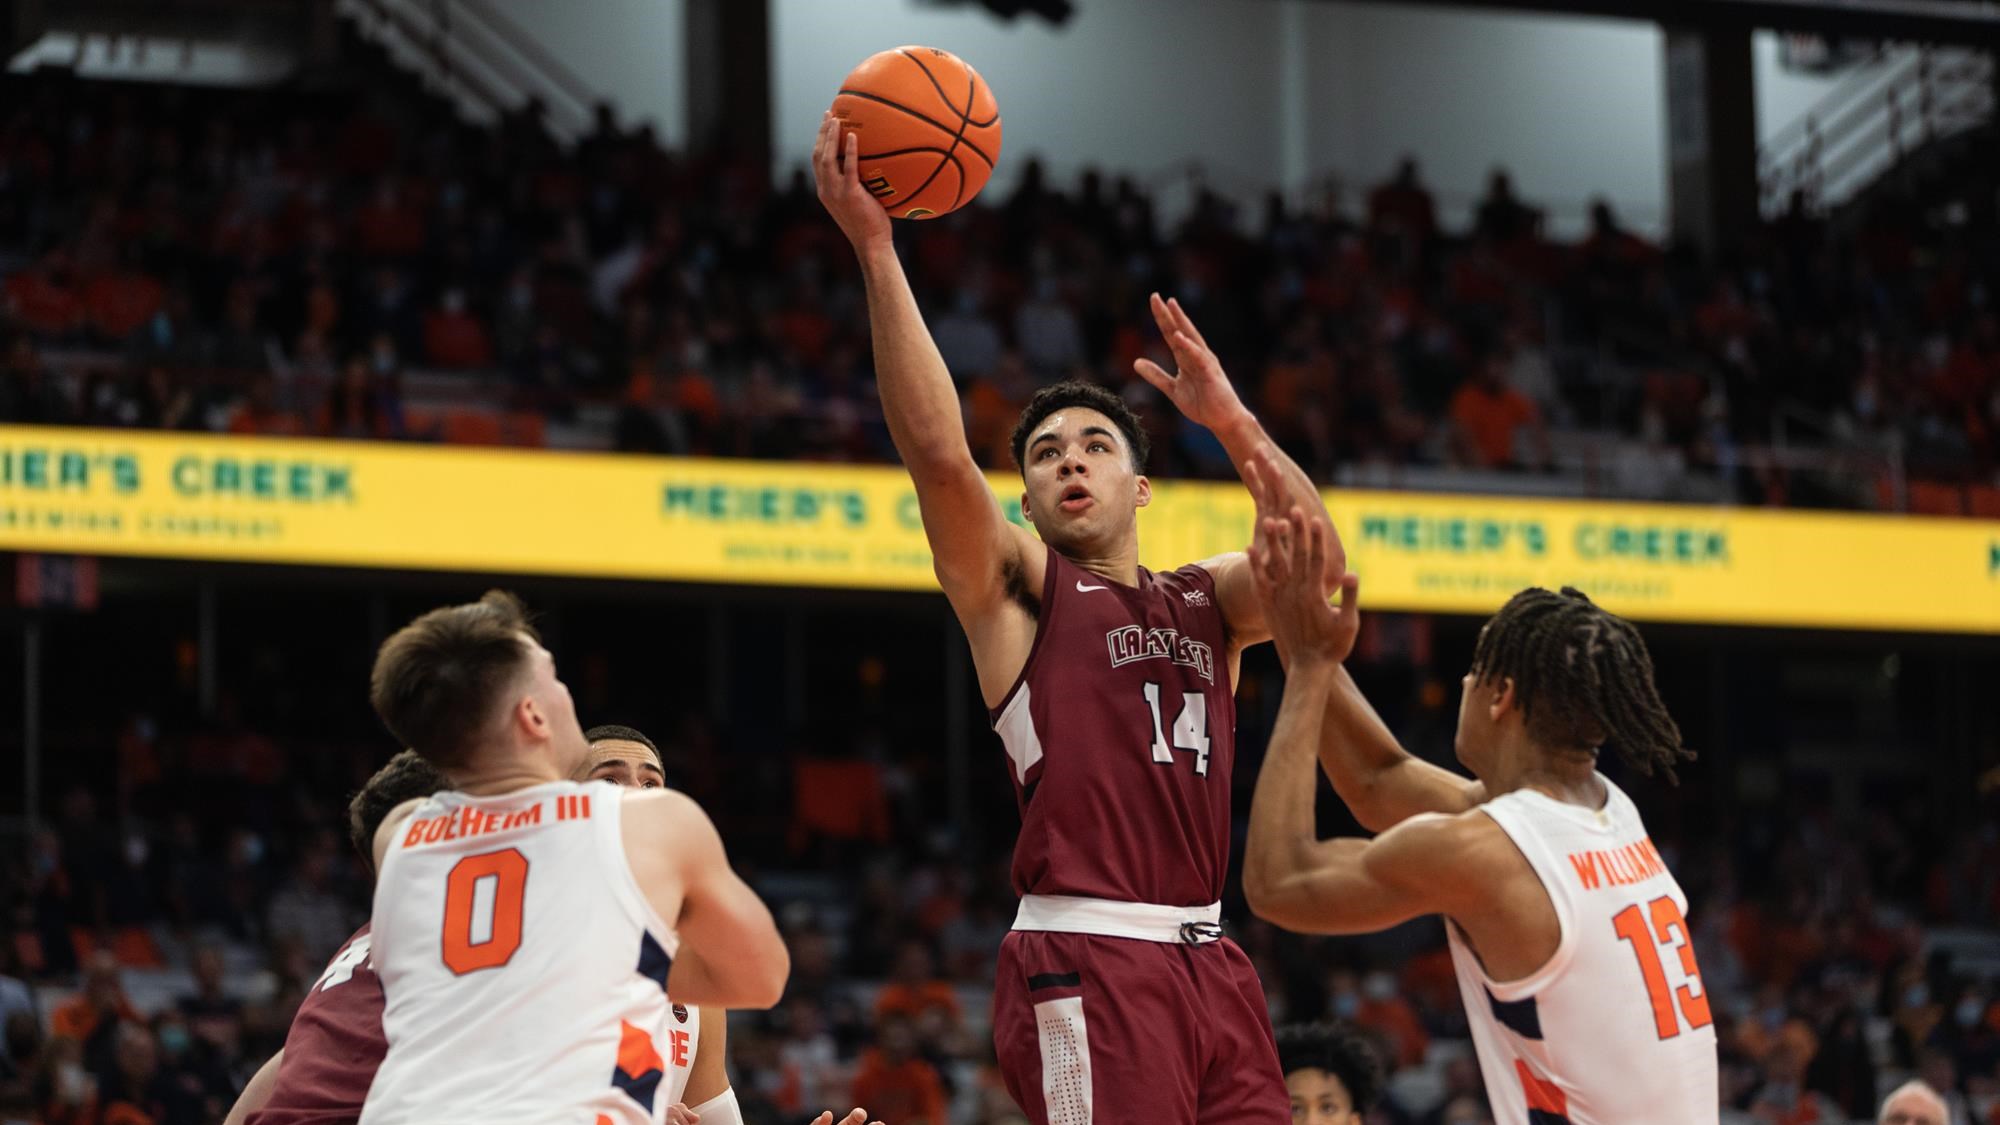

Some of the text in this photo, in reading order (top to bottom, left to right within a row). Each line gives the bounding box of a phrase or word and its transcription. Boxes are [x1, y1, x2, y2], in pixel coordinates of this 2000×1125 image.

[172, 455, 356, 504] CREEK
[1573, 522, 1731, 566] CREEK
[1106, 624, 1214, 686] LAAYETE
[1142, 680, 1211, 778] 14
[403, 795, 592, 848] BOEHEIM III
[441, 847, 530, 977] 0
[1611, 894, 1713, 1041] 13
